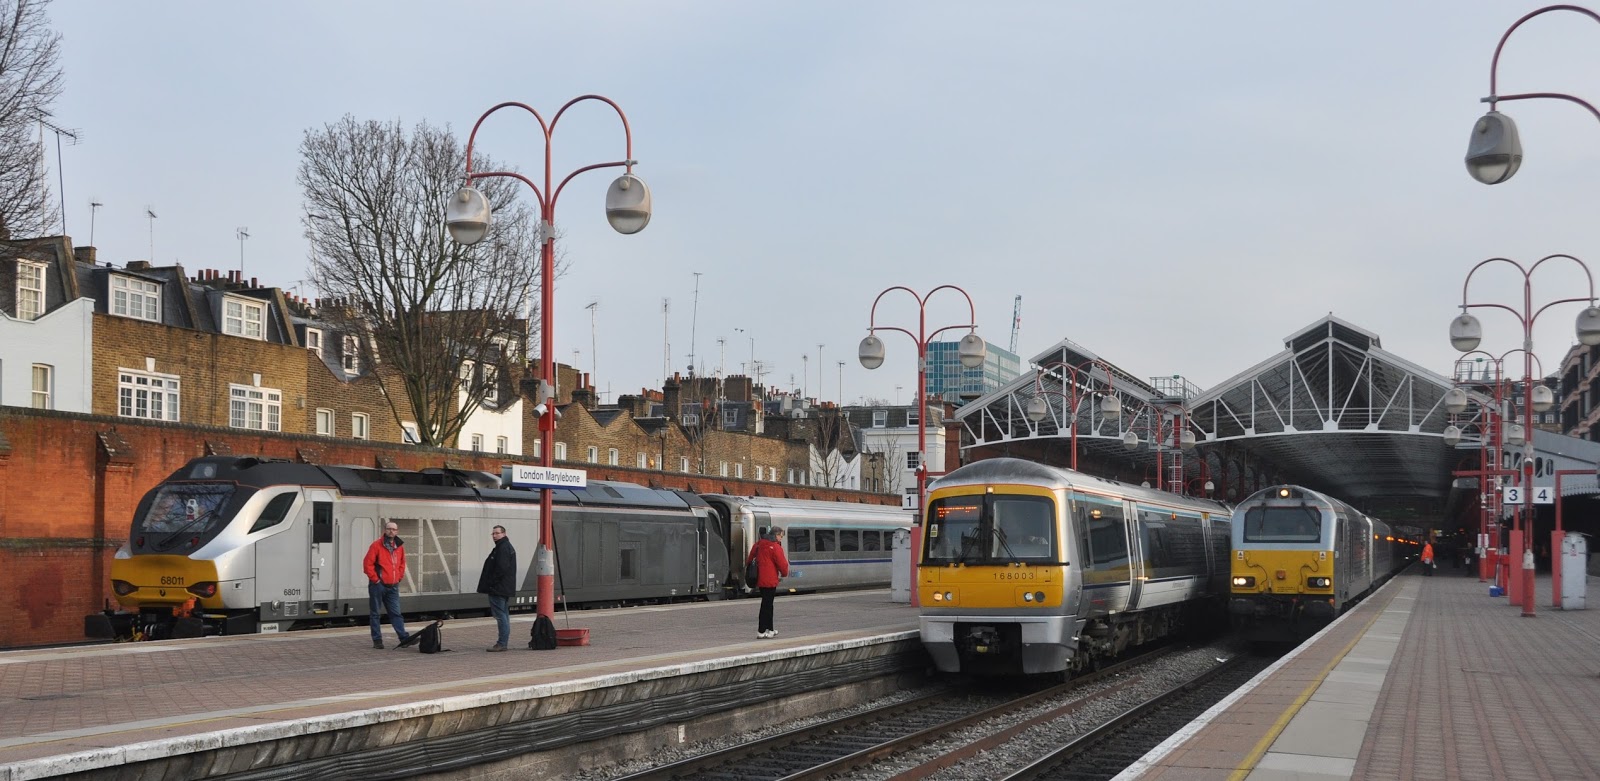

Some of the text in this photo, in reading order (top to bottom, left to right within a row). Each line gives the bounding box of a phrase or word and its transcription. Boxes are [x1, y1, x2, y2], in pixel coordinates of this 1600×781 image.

[520, 469, 580, 483] London Marylebone
[1508, 489, 1518, 501] 3
[1537, 489, 1548, 501] 4
[906, 496, 912, 507] 1
[320, 557, 325, 567] 2
[160, 576, 184, 585] 68011
[993, 572, 1034, 580] 168003
[283, 588, 301, 596] 68011
